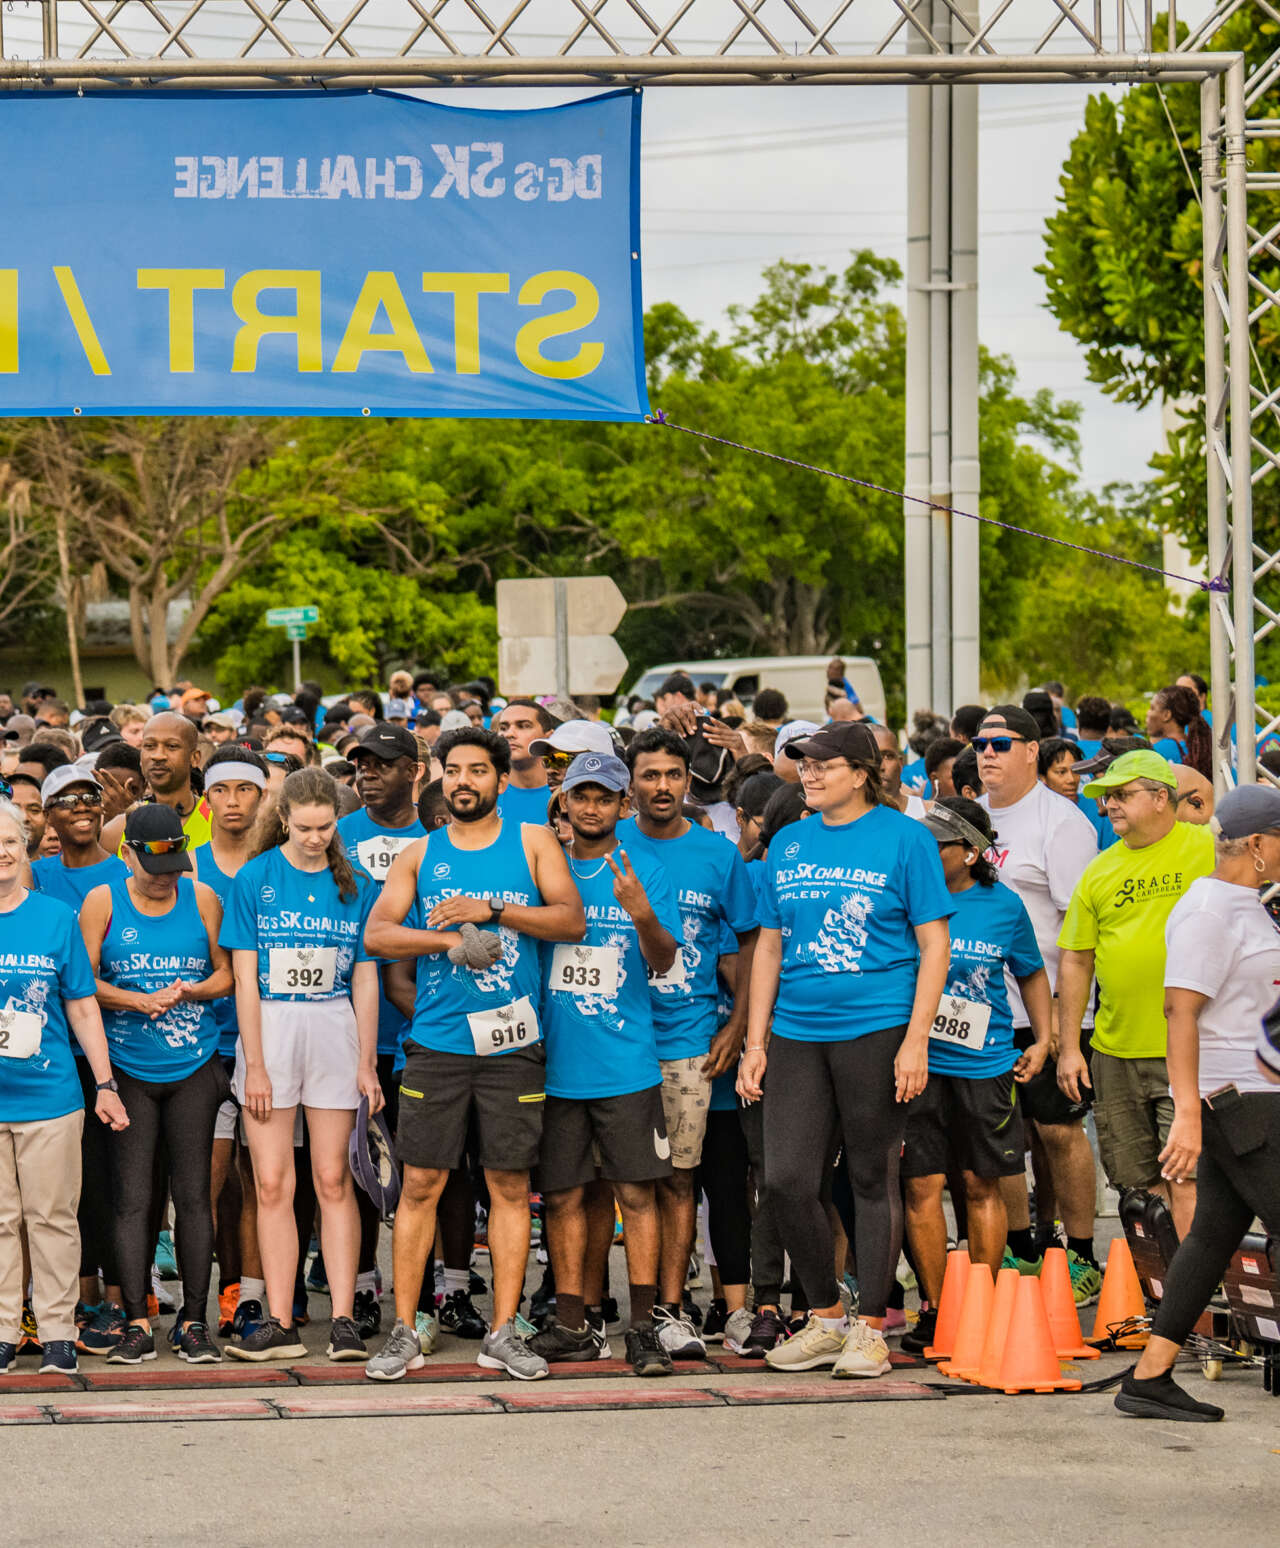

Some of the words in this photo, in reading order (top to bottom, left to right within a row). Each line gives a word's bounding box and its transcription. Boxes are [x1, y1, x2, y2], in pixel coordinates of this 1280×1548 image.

[795, 863, 817, 879] 5K
[814, 867, 888, 887] CHALLENGE
[1124, 872, 1183, 895] GRACE
[679, 890, 712, 908] LENGE
[280, 910, 302, 929] 5K
[303, 916, 360, 936] CHALLENG
[583, 904, 632, 922] ALLENG
[950, 937, 1003, 958] ALLENGE
[130, 953, 151, 970] 5K
[287, 968, 323, 987] 392
[562, 965, 601, 987] 933
[491, 1022, 527, 1047] 916
[932, 1014, 971, 1040] 988
